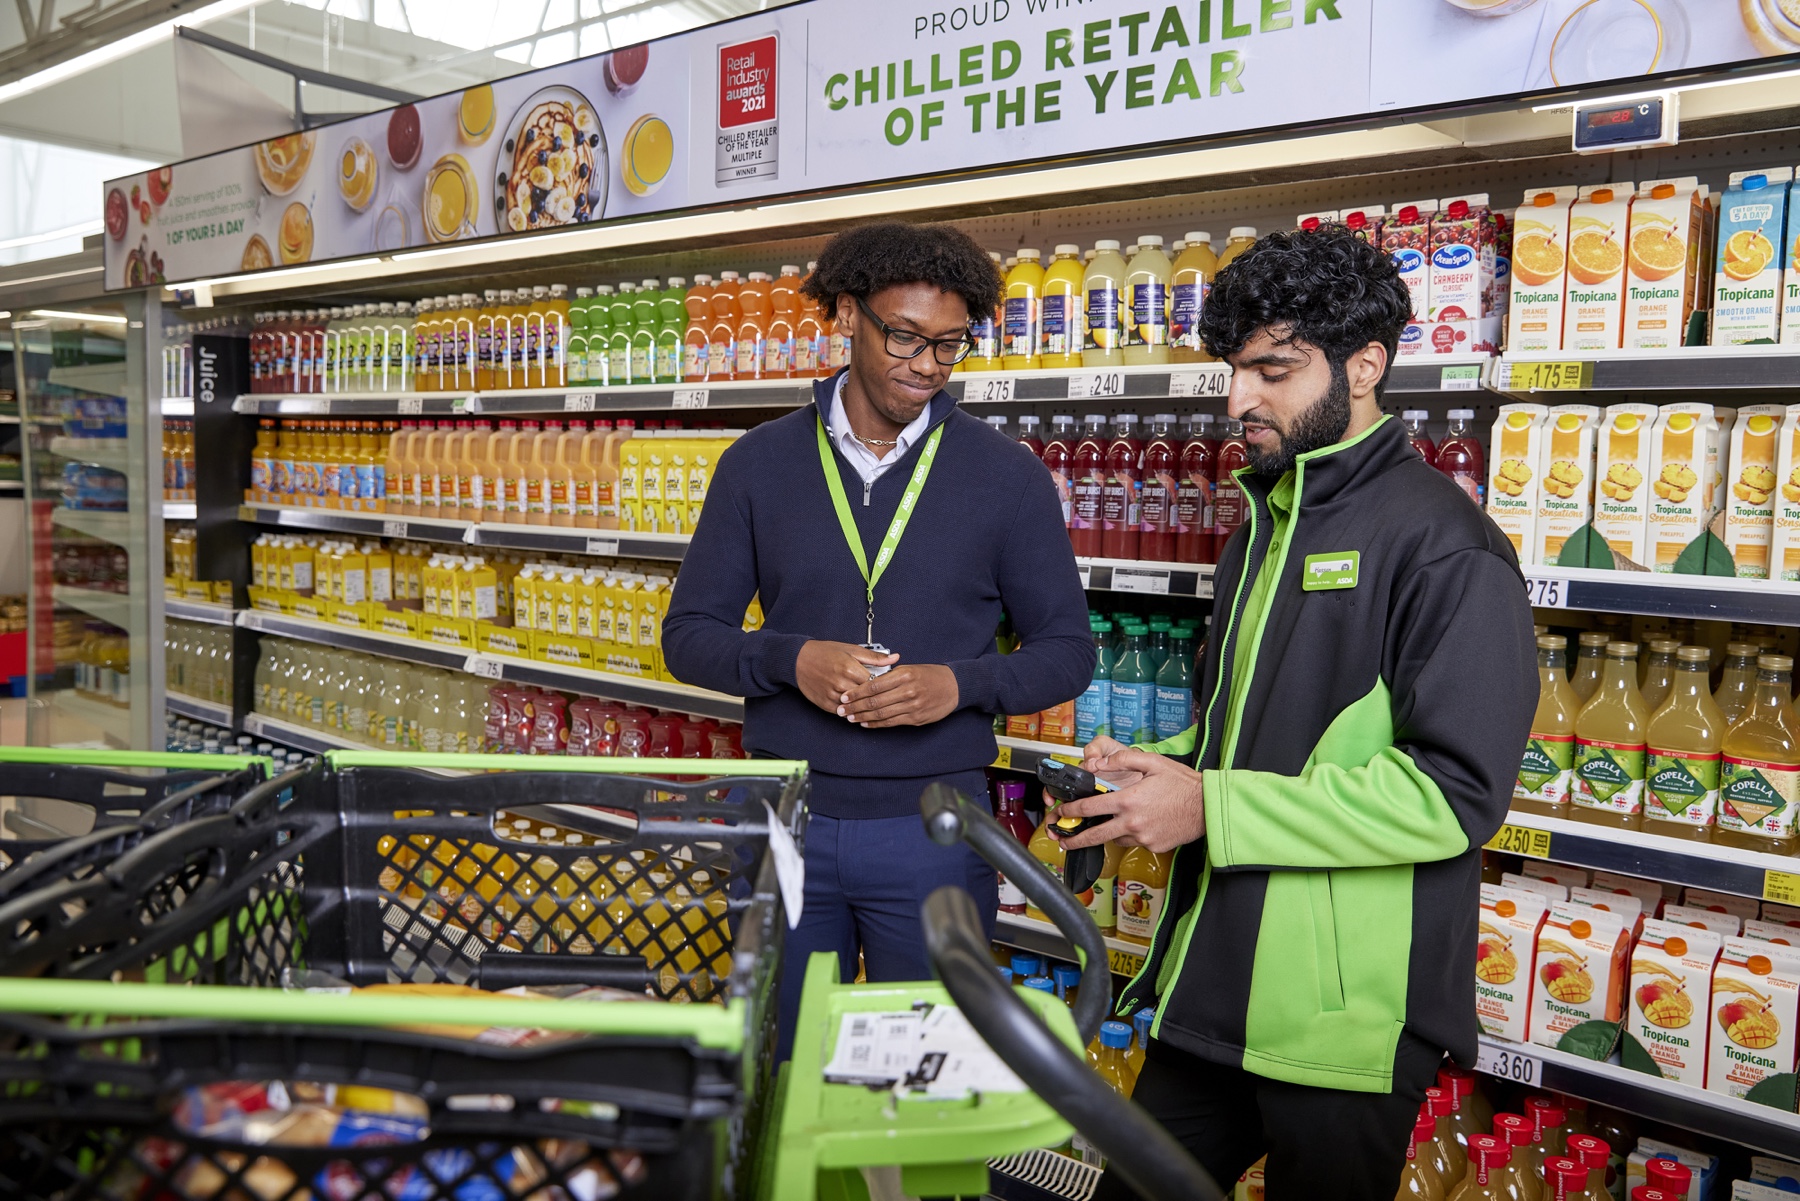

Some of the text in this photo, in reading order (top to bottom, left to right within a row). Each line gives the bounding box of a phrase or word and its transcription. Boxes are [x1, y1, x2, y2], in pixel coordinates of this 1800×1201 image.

[914, 0, 1010, 39] PROUD
[726, 51, 755, 72] Retail
[824, 0, 1342, 111] CHILLED RETAILER
[726, 67, 770, 87] Industry
[726, 80, 765, 101] awards
[884, 49, 1245, 146] OF THE YEAR
[741, 95, 766, 113] 2021
[717, 126, 778, 145] CHILLED RETAILER
[725, 136, 769, 152] OF THE YEAR
[731, 150, 762, 163] MULTIPLE
[735, 167, 757, 176] WINNER
[1749, 211, 1768, 219] DAY!
[166, 219, 245, 245] 1 OF YOUR 5 A DAY
[1403, 256, 1420, 270] Spray
[1434, 251, 1471, 265] Ocean Spray
[1433, 273, 1474, 285] CRANBERRY
[1513, 291, 1559, 304] Tropicana
[1569, 290, 1617, 304] Tropicana
[1629, 287, 1680, 301] Tropicana
[1717, 287, 1775, 303] Tropicana
[1577, 307, 1606, 315] ORANGE
[1638, 304, 1668, 312] ORANGE
[1715, 306, 1773, 317] SMOOTH ORANGE
[199, 346, 218, 404] Juice
[983, 380, 1010, 401] £2.75
[1090, 373, 1119, 396] £2.40
[1193, 373, 1225, 396] £2.40
[925, 438, 936, 458] ASDA
[914, 464, 926, 484] ASDA
[1087, 486, 1101, 495] BURST
[1111, 487, 1124, 496] BURST
[1152, 487, 1166, 497] BURST
[1185, 488, 1199, 498] BURST
[1225, 489, 1240, 498] BURST
[902, 491, 915, 511] ASDA
[1494, 497, 1527, 508] Tropicana
[1545, 499, 1578, 510] Tropicana
[1489, 505, 1533, 516] Sensations
[1539, 508, 1584, 519] Sensations
[1602, 503, 1637, 513] Tropicana
[1655, 504, 1692, 515] Tropicana
[1735, 506, 1773, 517] Tropicana
[1596, 511, 1643, 522] Sensations
[1649, 513, 1698, 524] Sensations
[889, 519, 903, 539] ASDA
[877, 547, 890, 567] ASDA
[1336, 577, 1354, 585] ASDA
[578, 651, 591, 659] ASDA
[1111, 684, 1137, 695] Tropicana
[1157, 689, 1185, 700] Tropicana
[1124, 701, 1138, 709] FOR
[1155, 703, 1185, 714] FUEL FOR
[1155, 711, 1185, 722] THOUGHT
[1583, 760, 1621, 777] COPELLA
[1654, 771, 1695, 788] COPELLA
[1731, 780, 1773, 799] COPELLA
[1736, 806, 1767, 816] ELDERFLOWER
[1499, 827, 1530, 854] £2.50
[1122, 914, 1150, 925] innocent
[1585, 942, 1606, 951] VITAMIN
[1681, 961, 1703, 970] VITAMIN
[1766, 979, 1791, 989] VITAMIN
[1479, 997, 1503, 1009] ORANGE
[1483, 1003, 1505, 1015] MANGO
[1544, 999, 1591, 1019] Tropicana
[1553, 1014, 1580, 1024] ORANGE
[1641, 1025, 1690, 1048] Tropicana
[1650, 1042, 1678, 1054] ORANGE
[1655, 1050, 1681, 1061] MANGO
[1724, 1045, 1777, 1069] Tropicana
[1493, 1051, 1533, 1083] £3.60
[1734, 1063, 1764, 1076] ORANGE
